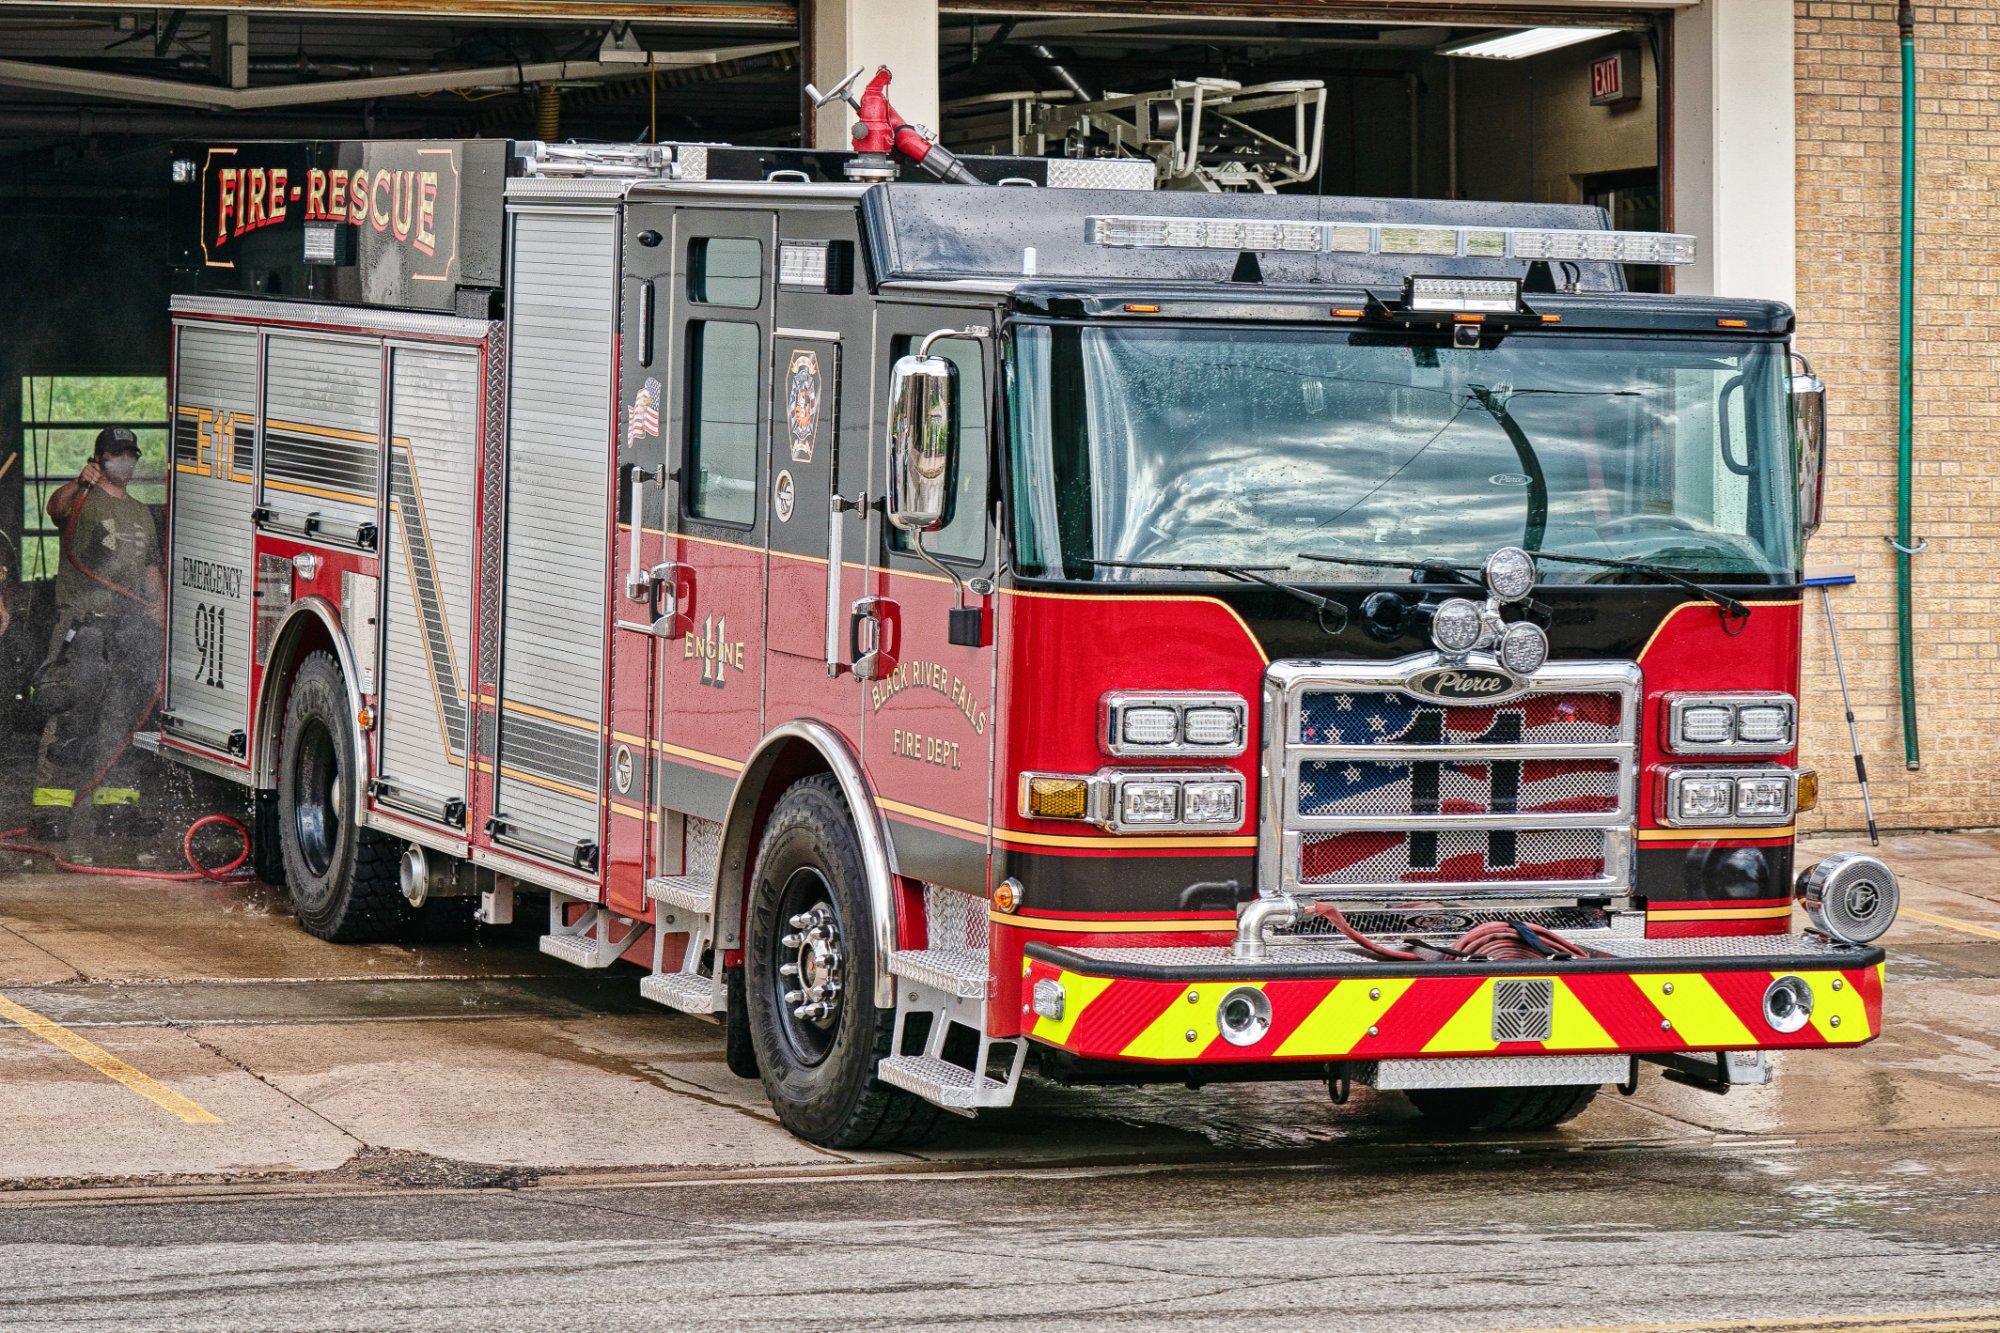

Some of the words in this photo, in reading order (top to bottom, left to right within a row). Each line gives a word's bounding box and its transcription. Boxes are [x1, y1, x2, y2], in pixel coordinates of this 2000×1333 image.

[1594, 60, 1617, 96] EXIT
[197, 408, 235, 481] E11
[182, 556, 243, 599] EMERGENCY
[195, 602, 225, 690] 911
[684, 630, 745, 671] ENGINE
[701, 611, 726, 686] 11
[871, 663, 909, 712] BLACK
[912, 661, 948, 695] RIVER
[951, 676, 986, 735] FALLS
[1433, 671, 1502, 695] Pierce
[893, 729, 922, 760] FIRE
[926, 737, 961, 769] DEPT.
[1376, 707, 1526, 872] 11
